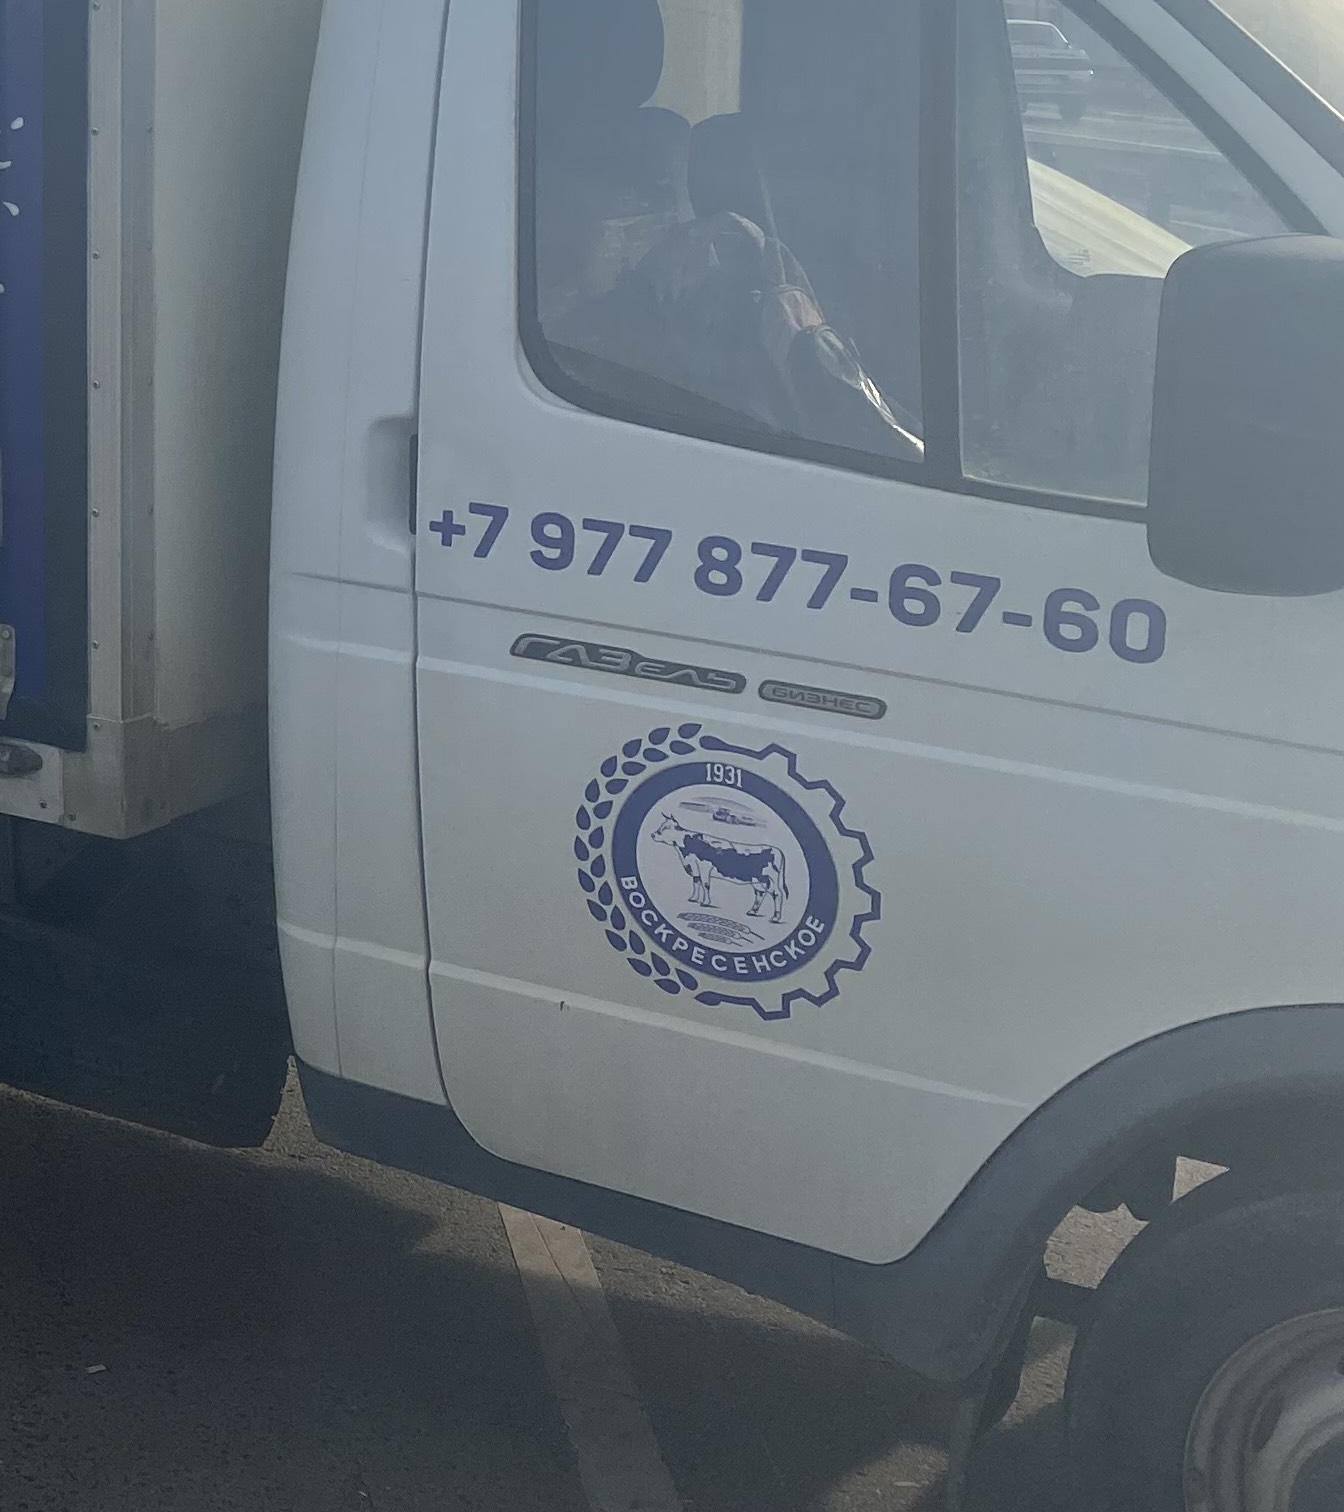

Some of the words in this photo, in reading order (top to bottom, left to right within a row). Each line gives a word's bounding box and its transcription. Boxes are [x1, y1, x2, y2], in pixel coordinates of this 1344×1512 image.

[428, 501, 511, 559] +7
[529, 511, 674, 584] 977
[691, 534, 1168, 665] 877-67-60
[704, 763, 743, 787] 1931
[620, 875, 825, 974] ВОСКРЕСЕНСКОЕ
